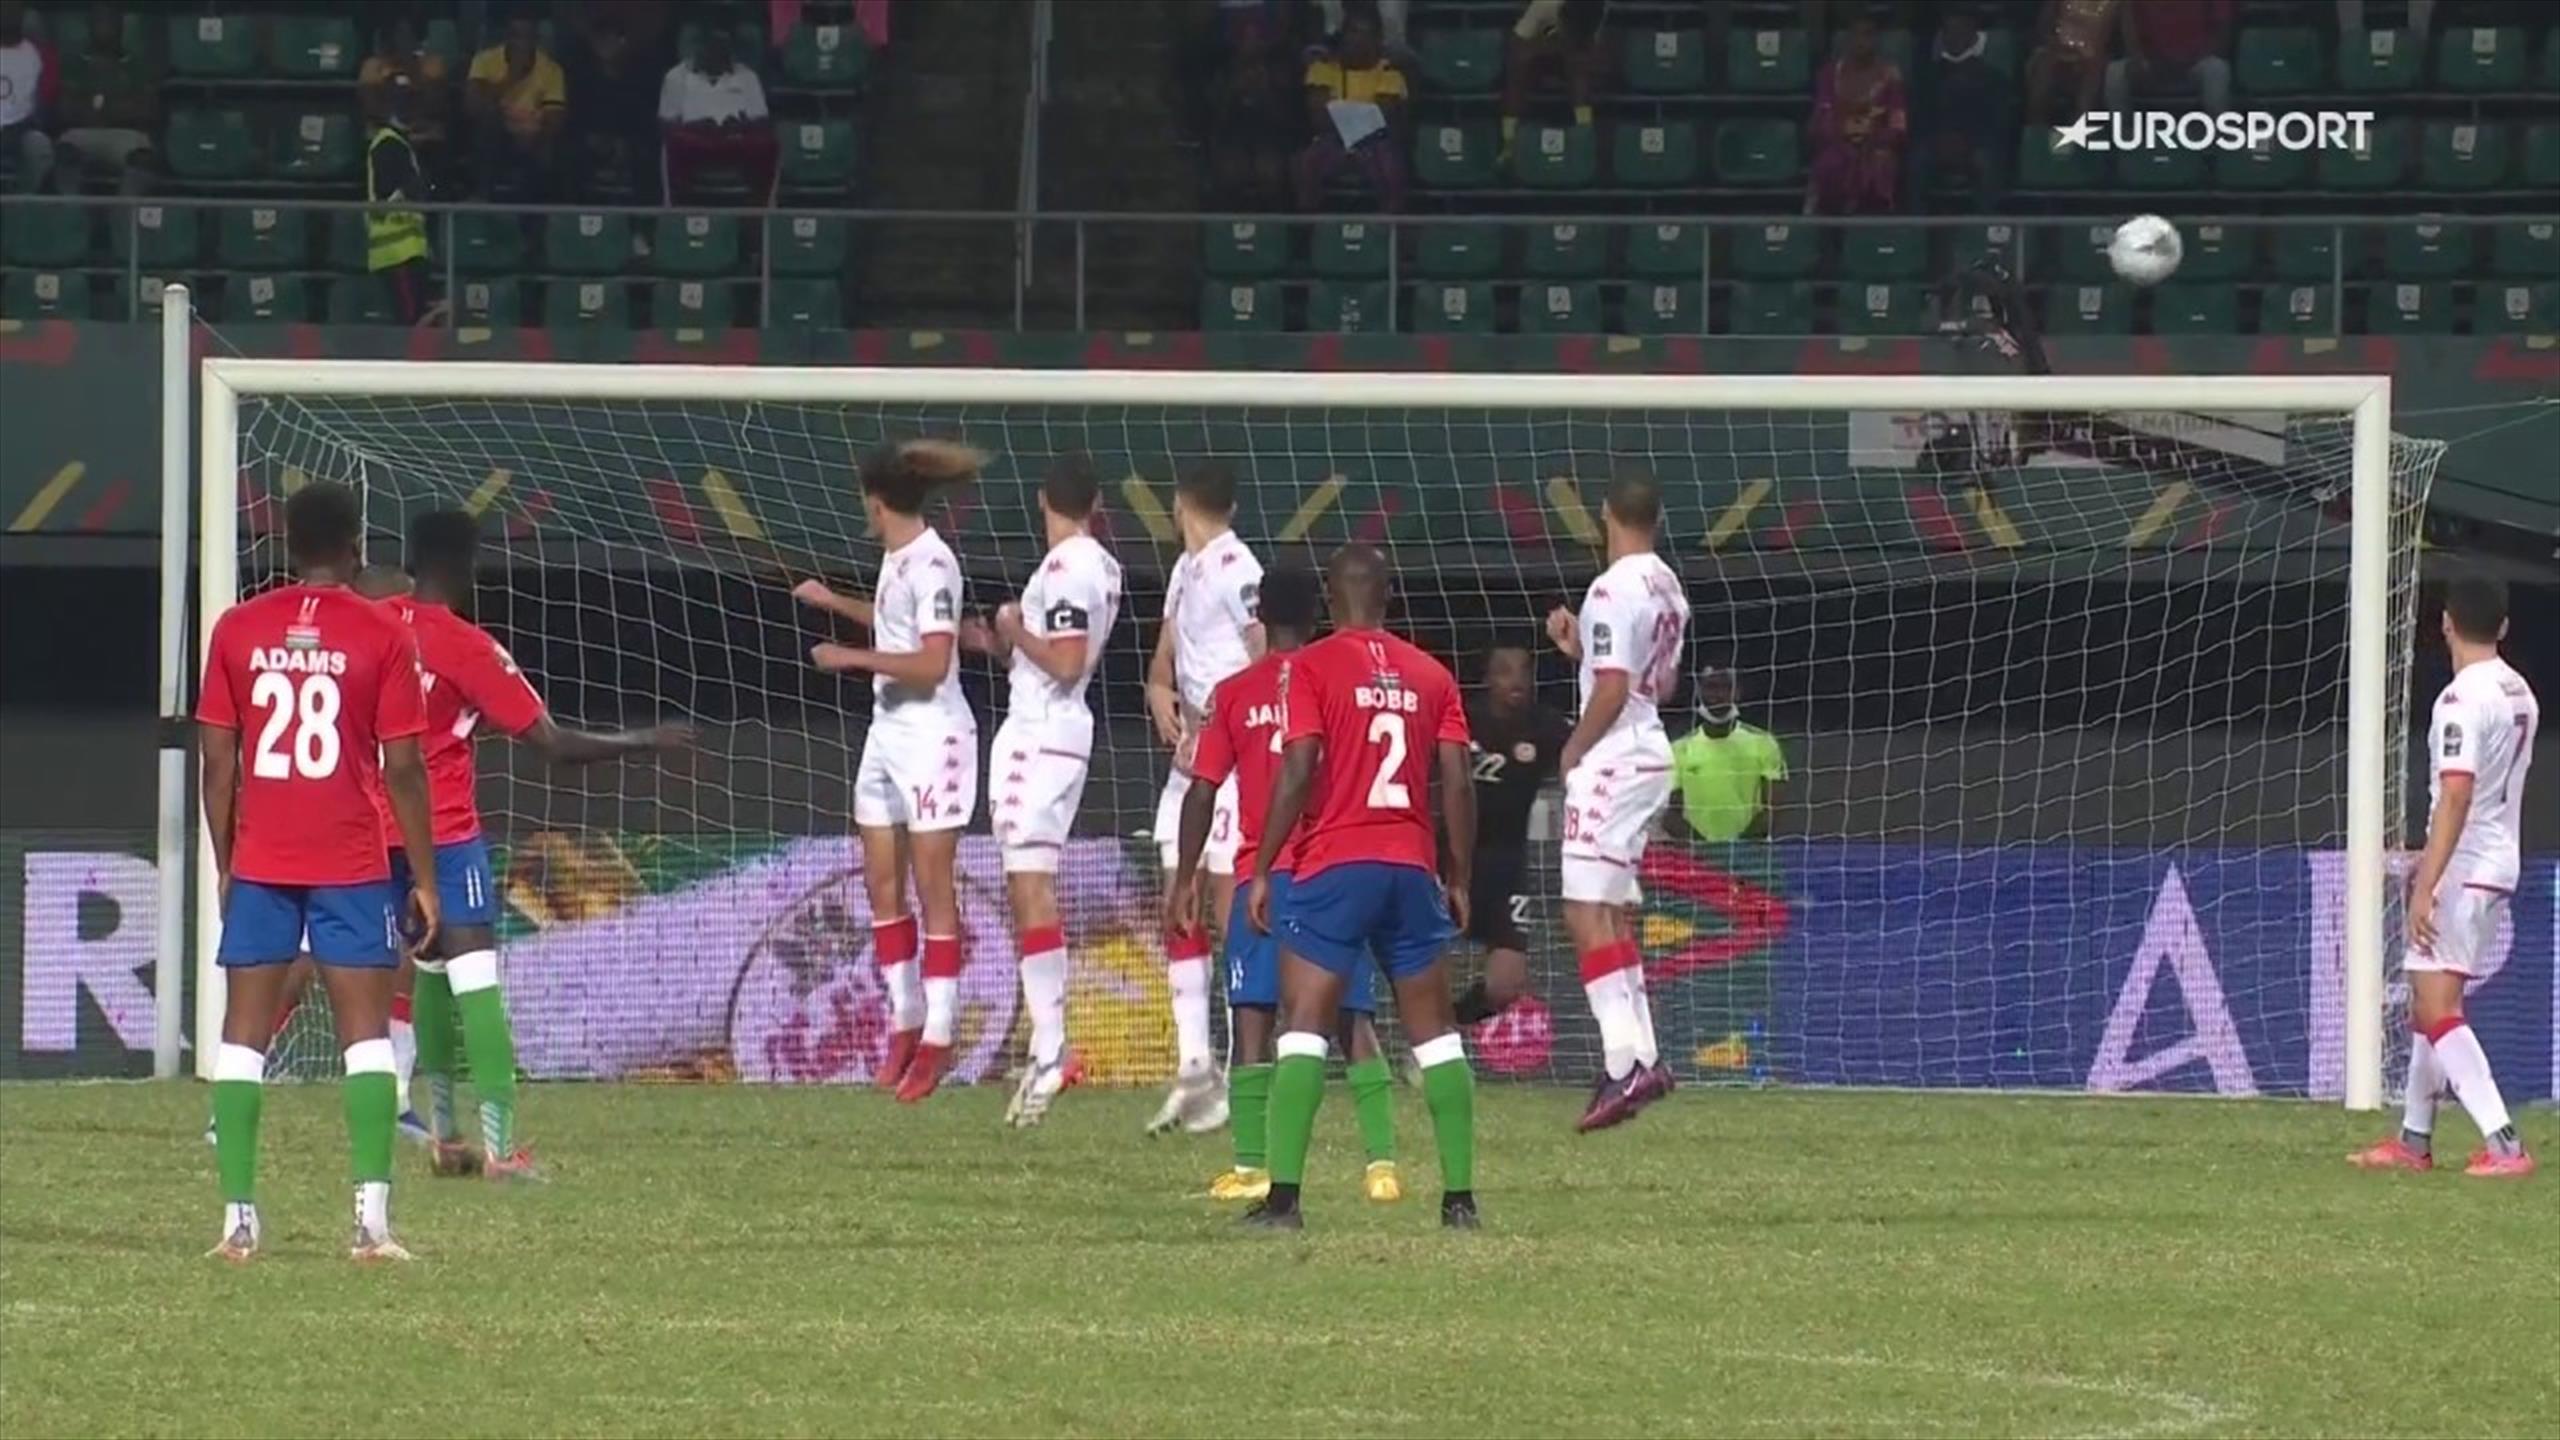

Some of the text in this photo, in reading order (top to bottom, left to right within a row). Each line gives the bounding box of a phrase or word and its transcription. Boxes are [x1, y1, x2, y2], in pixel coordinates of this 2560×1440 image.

[1054, 610, 1073, 629] C
[249, 647, 347, 674] ADAMS
[1355, 686, 1418, 713] BOBB
[250, 671, 342, 780] 28
[1366, 711, 1411, 809] 2
[2501, 713, 2528, 803] 7
[911, 784, 938, 821] 14
[1212, 806, 1232, 843] 3
[23, 852, 192, 1050] R
